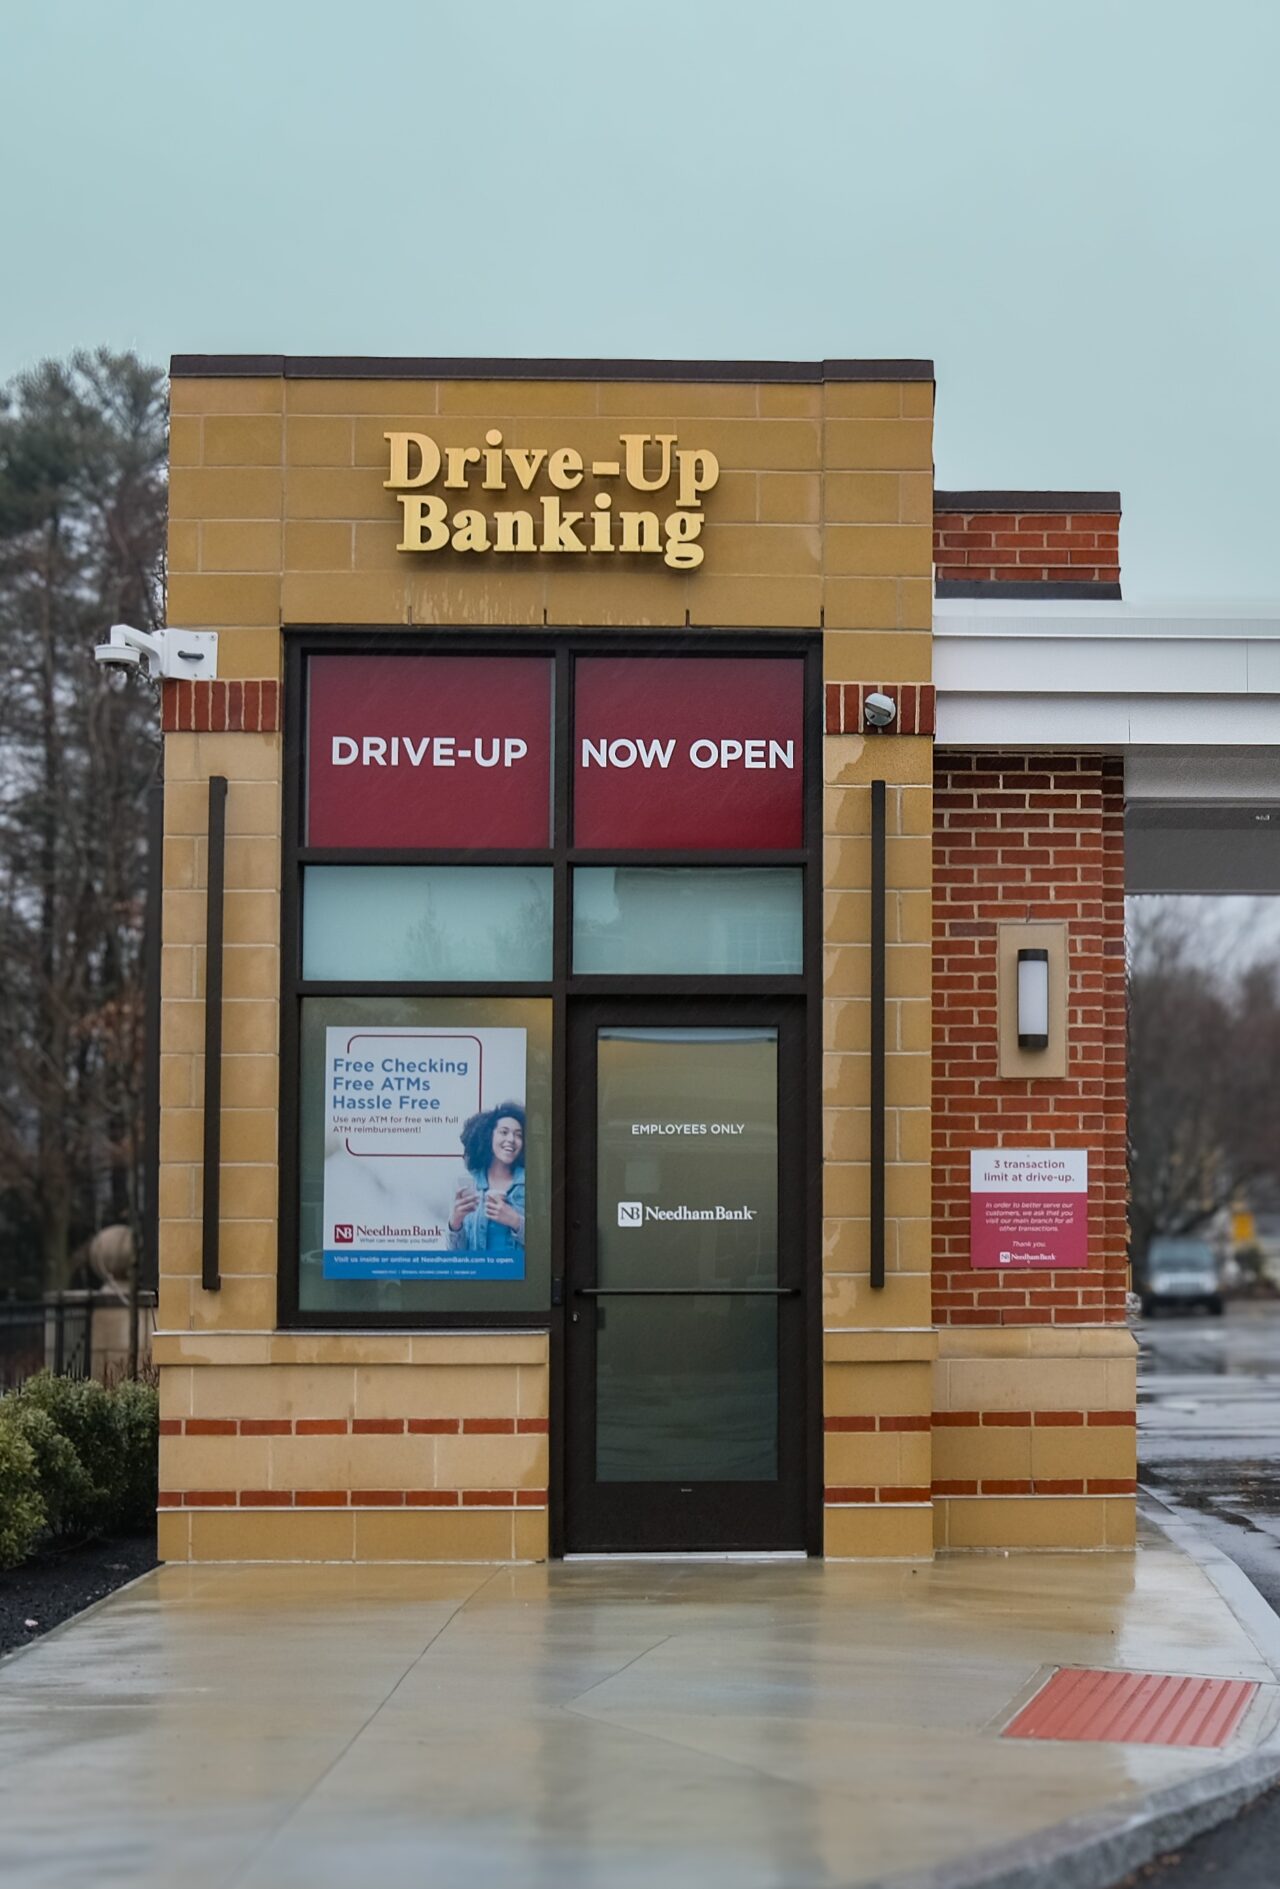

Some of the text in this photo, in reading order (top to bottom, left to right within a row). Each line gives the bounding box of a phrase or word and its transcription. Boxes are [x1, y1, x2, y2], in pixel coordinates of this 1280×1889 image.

[383, 428, 720, 507] Drive-Up
[396, 492, 705, 569] Banking
[331, 735, 529, 767] DRIVE-UP
[581, 738, 795, 769] NOW OPEN
[333, 1057, 468, 1076] Free Checking
[333, 1077, 431, 1091] Free ATMs
[333, 1095, 440, 1110] Hassle Free
[333, 1116, 349, 1124] Use
[351, 1117, 366, 1125] any
[404, 1116, 422, 1124] free
[354, 1126, 422, 1134] reimbursement!
[631, 1124, 745, 1135] EMPLOYEES ONLY
[994, 1160, 1065, 1169] 3 transaction
[984, 1172, 1075, 1183] limit at drive-up.
[620, 1207, 640, 1221] NB
